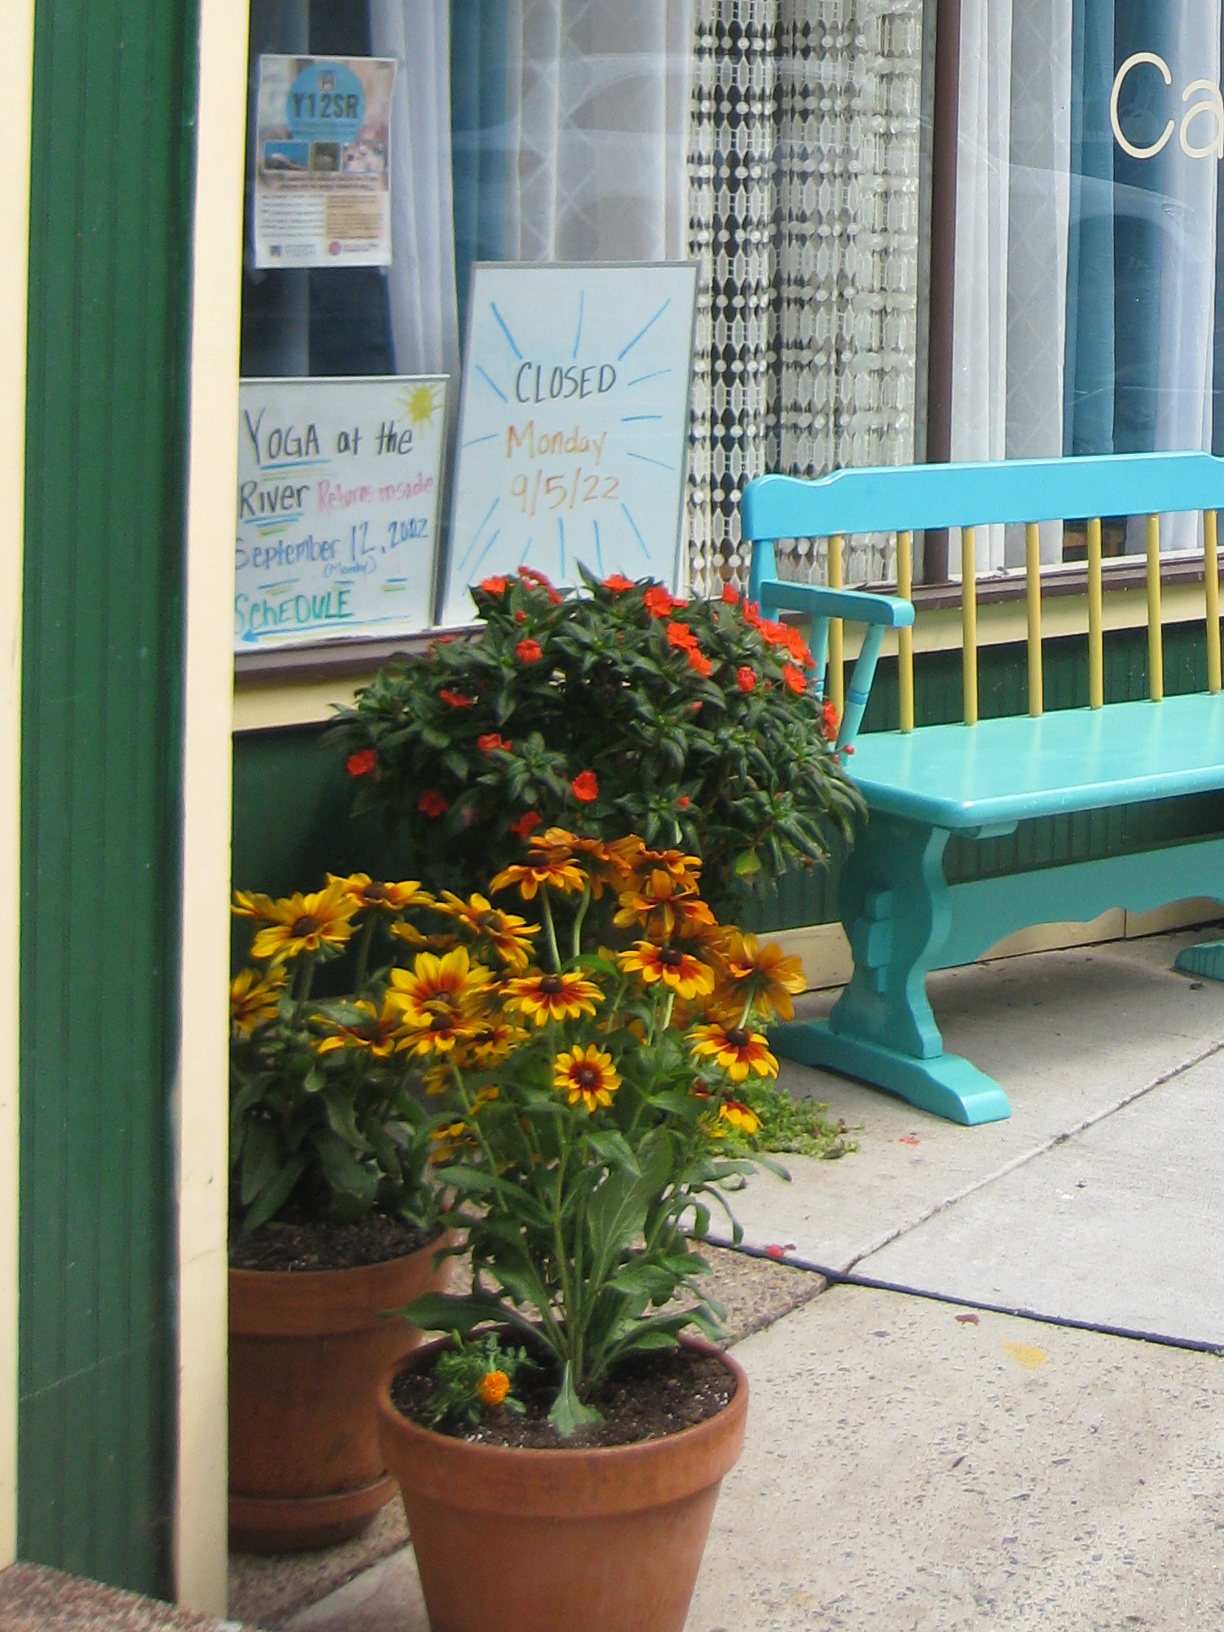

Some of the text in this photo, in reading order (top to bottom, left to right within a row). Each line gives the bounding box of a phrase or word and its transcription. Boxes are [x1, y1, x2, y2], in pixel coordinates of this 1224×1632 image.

[291, 92, 360, 119] Y12SR
[515, 361, 617, 404] CLOSED
[244, 406, 413, 465] YOGA at the
[506, 420, 608, 466] Monday
[238, 480, 311, 520] River
[511, 467, 620, 516] 9/5/22
[235, 534, 341, 569] September
